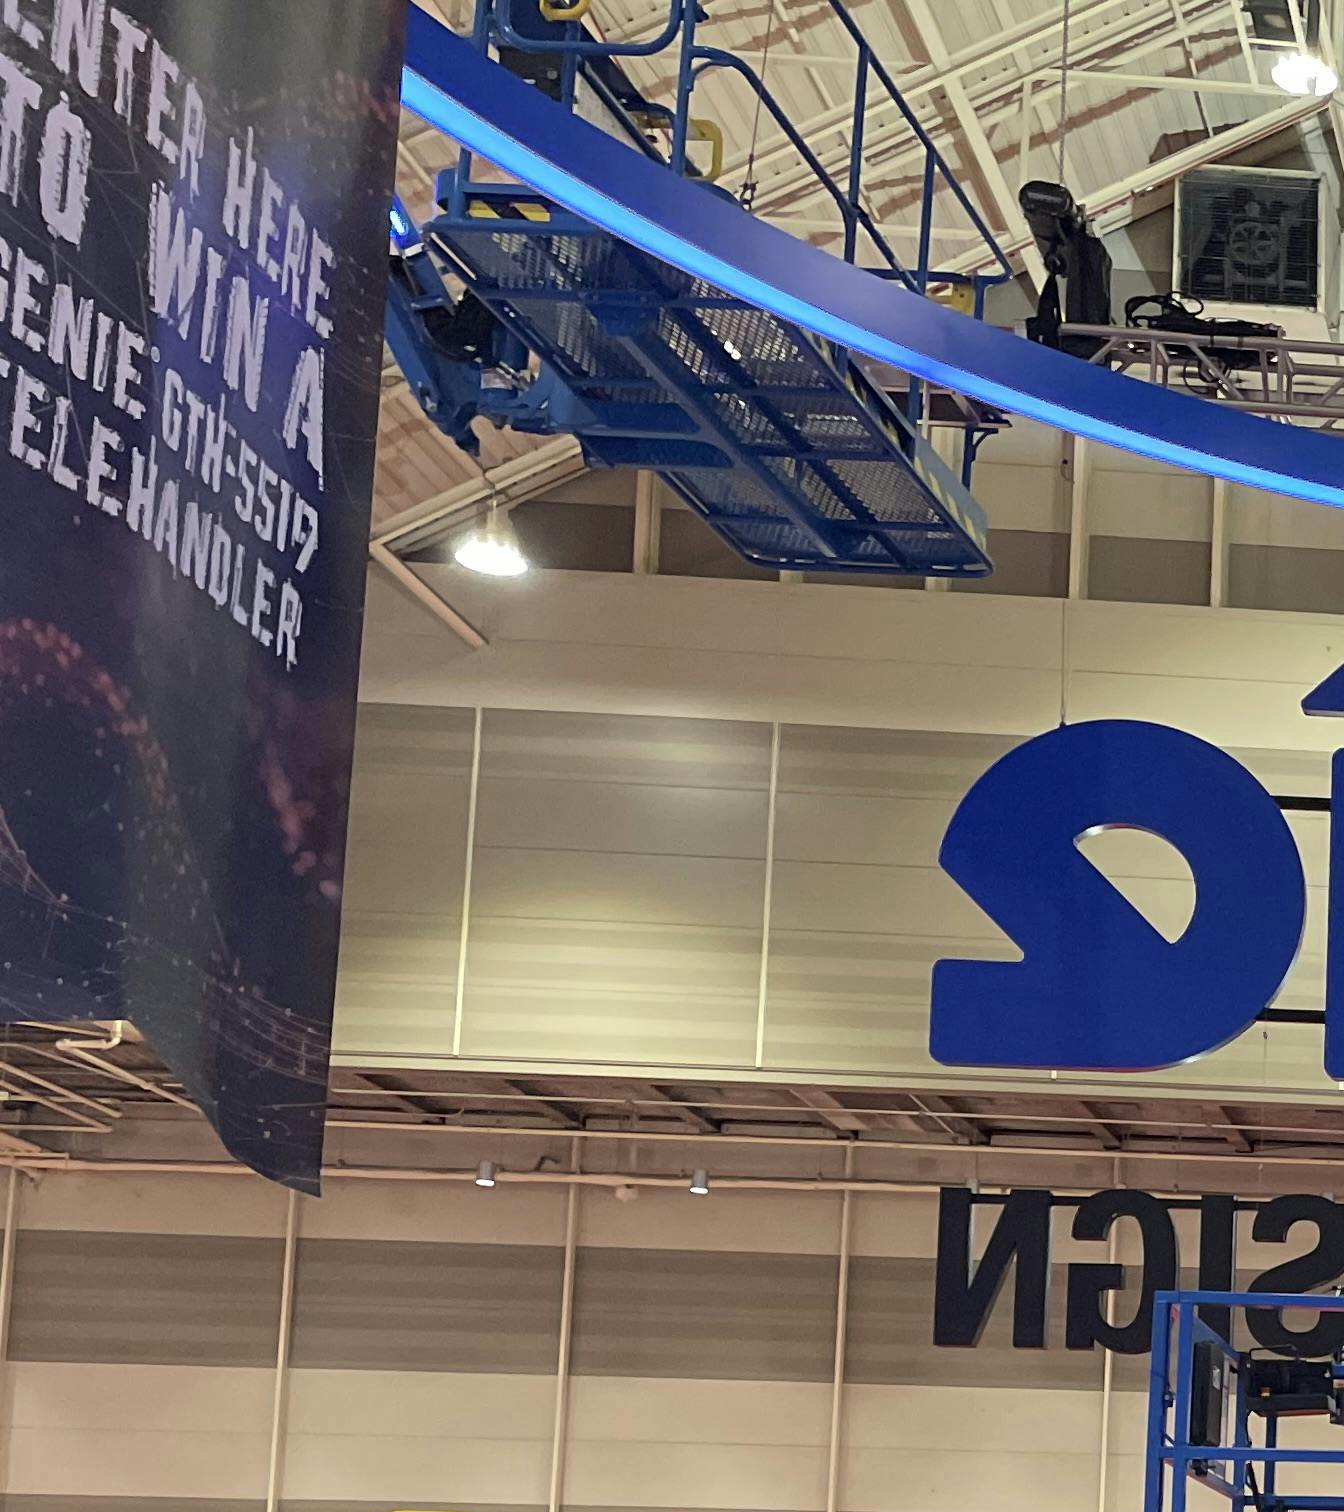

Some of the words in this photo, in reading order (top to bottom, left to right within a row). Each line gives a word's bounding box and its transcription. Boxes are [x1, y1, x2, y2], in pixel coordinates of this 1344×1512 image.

[0, 52, 91, 250] TO
[149, 180, 269, 412] WIN
[283, 346, 325, 491] A
[222, 126, 336, 339] HERE
[163, 368, 319, 574] GTH-5519
